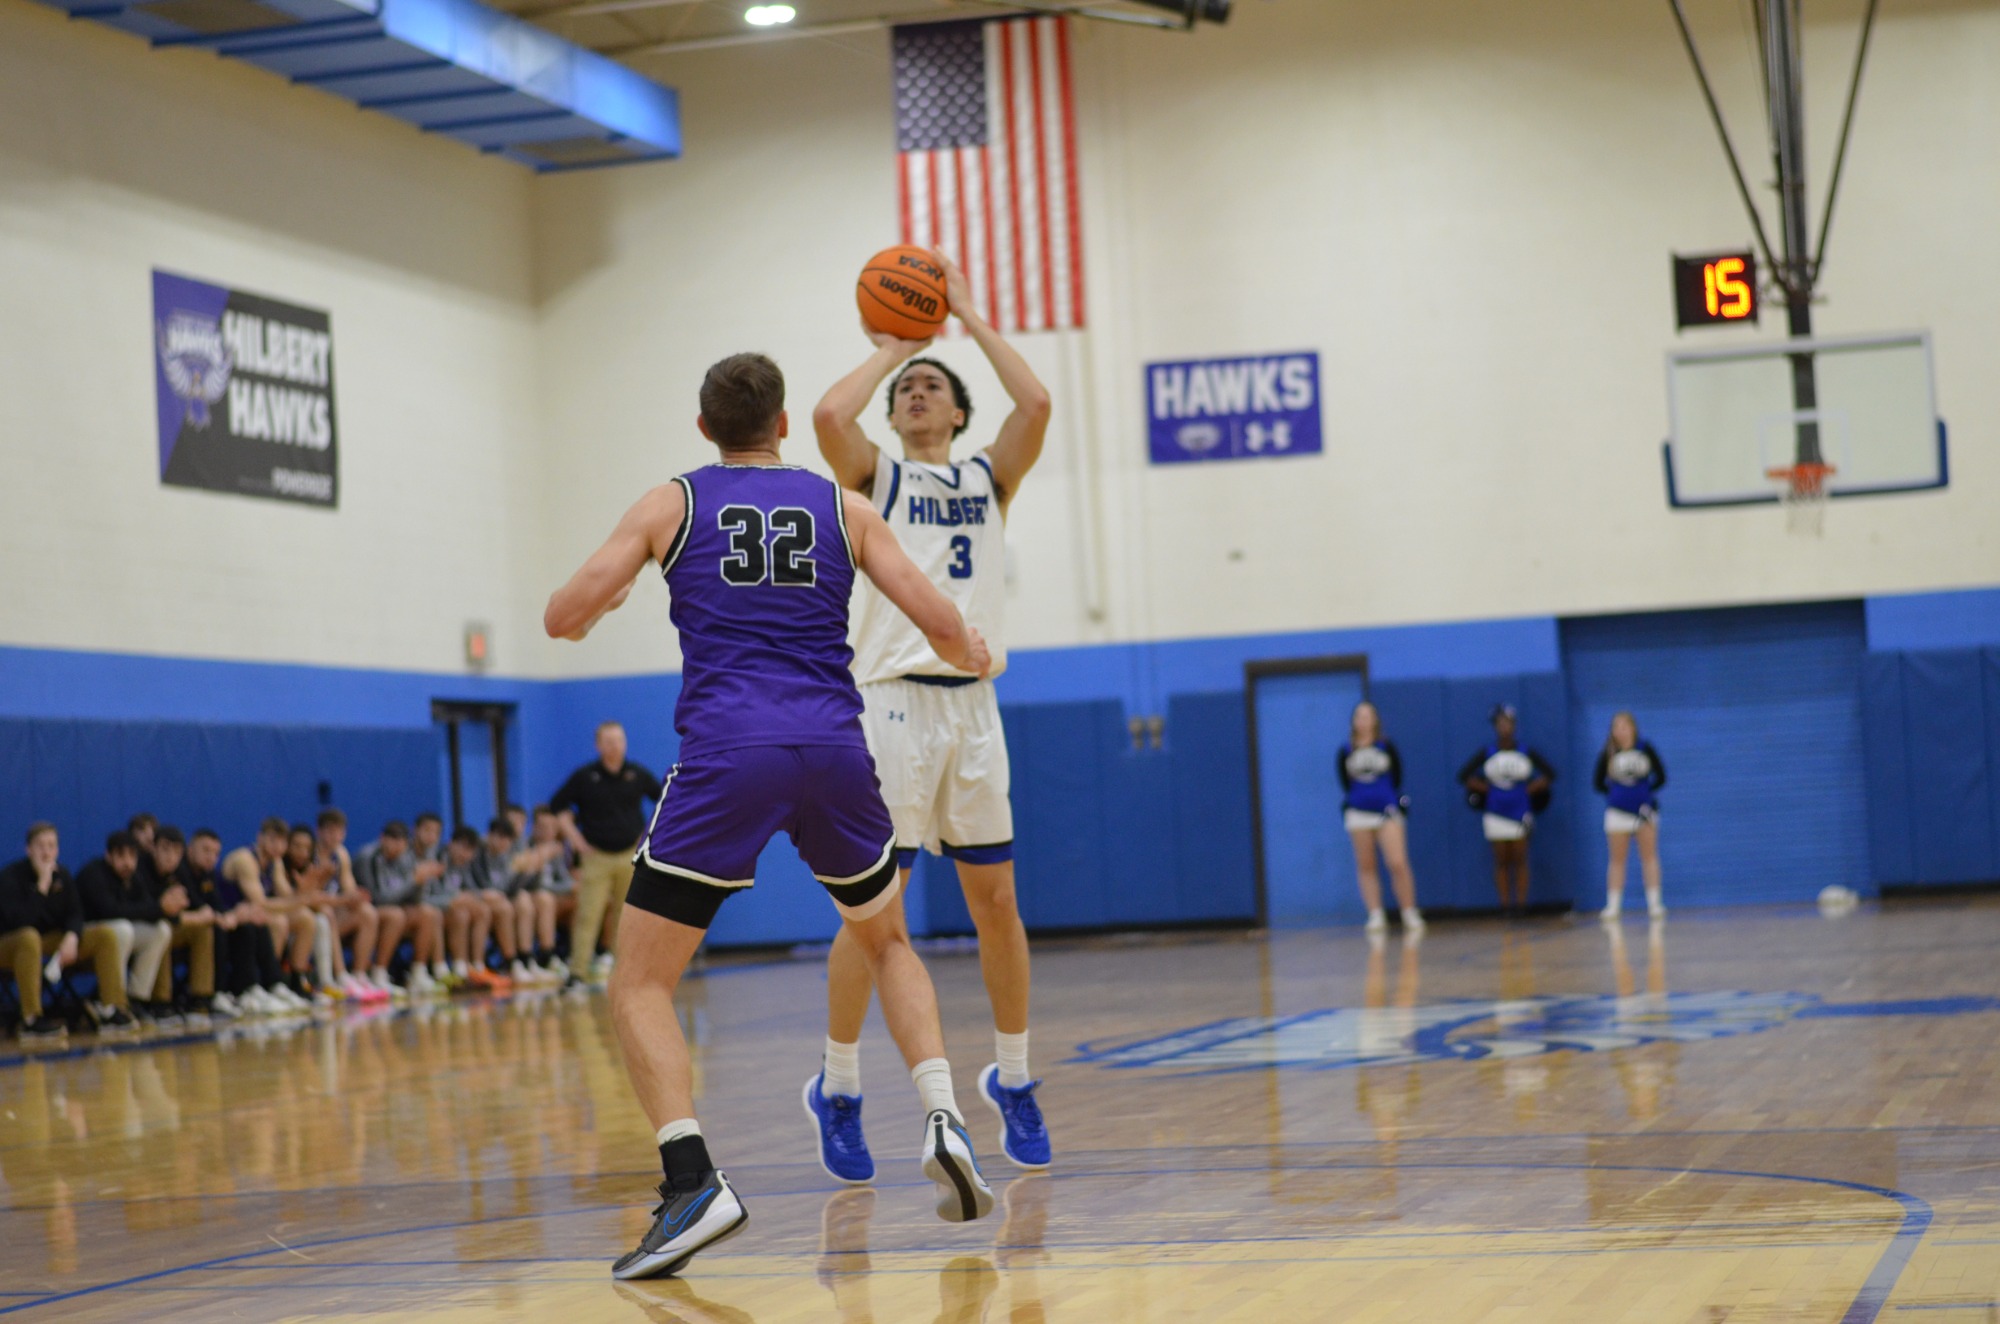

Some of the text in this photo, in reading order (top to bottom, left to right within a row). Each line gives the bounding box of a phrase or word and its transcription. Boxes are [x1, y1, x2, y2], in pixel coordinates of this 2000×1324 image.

[879, 275, 938, 317] Wilson
[1703, 257, 1752, 319] 15
[222, 309, 330, 388] HILBERT
[229, 377, 332, 452] HAWKS
[1152, 357, 1314, 420] HAWKS
[718, 504, 816, 588] 32
[948, 535, 973, 579] 3
